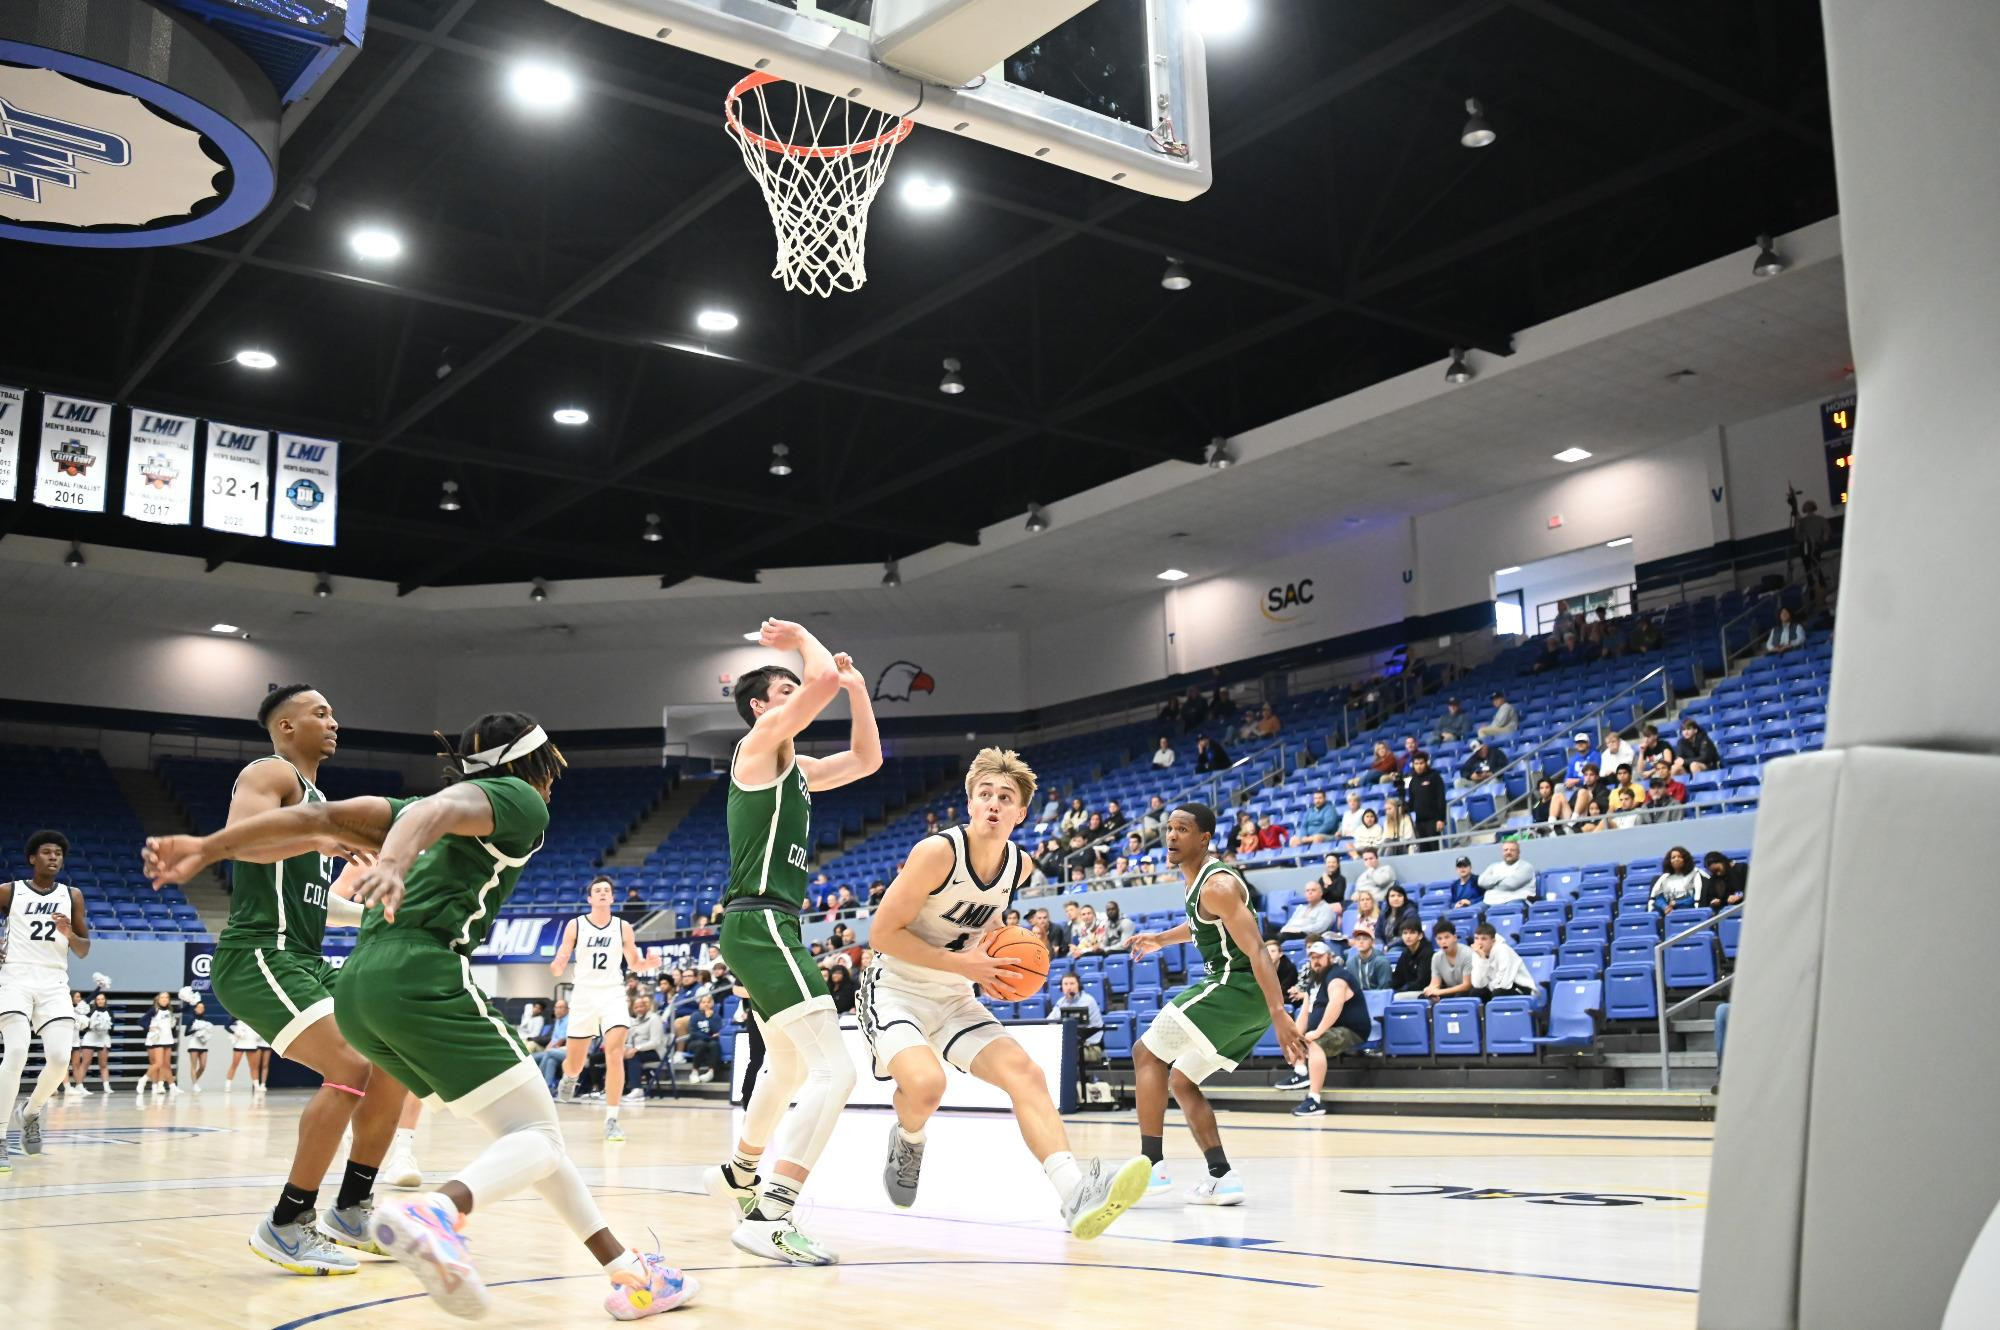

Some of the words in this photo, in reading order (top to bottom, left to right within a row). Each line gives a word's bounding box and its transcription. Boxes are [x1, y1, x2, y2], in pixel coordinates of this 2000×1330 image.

[51, 400, 101, 424] LMU
[1833, 410, 1847, 429] 4
[45, 422, 65, 432] MEN'S
[66, 425, 106, 438] BASKETBALL
[138, 414, 186, 438] LMU
[152, 438, 189, 451] BASKETALL
[215, 429, 259, 452] LMU
[285, 441, 328, 463] LMU
[40, 477, 71, 488] ATIONAL
[54, 490, 84, 505] 2016
[1711, 486, 1723, 503] V
[143, 503, 170, 517] 2017
[1402, 570, 1413, 584] U
[1268, 578, 1314, 612] SAC
[722, 686, 730, 697] S
[787, 843, 809, 873] COL
[24, 902, 61, 915] LMU
[939, 900, 1000, 929] LMU
[30, 920, 56, 942] 22
[587, 936, 612, 948] LMU
[592, 952, 607, 970] 12
